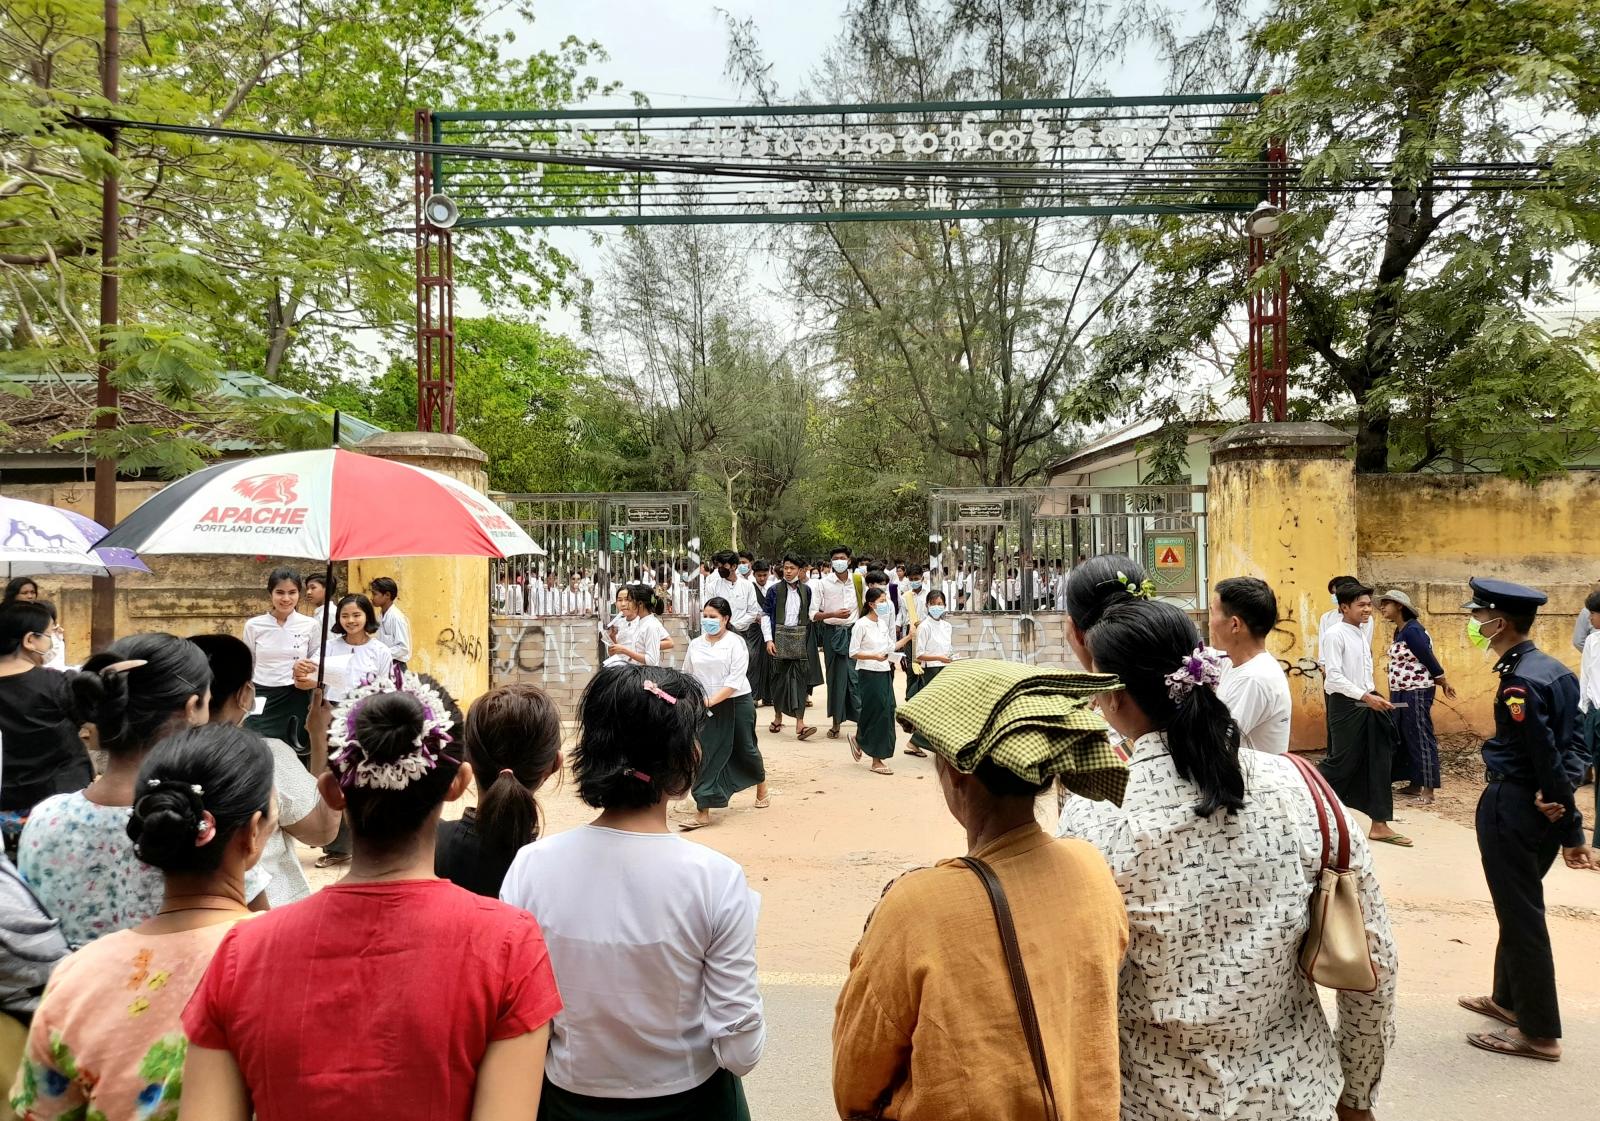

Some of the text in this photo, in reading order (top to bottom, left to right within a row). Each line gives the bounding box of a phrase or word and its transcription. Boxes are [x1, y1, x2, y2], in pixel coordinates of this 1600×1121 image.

[199, 506, 308, 525] APACHE
[193, 524, 301, 535] PORTLAND CEMENT
